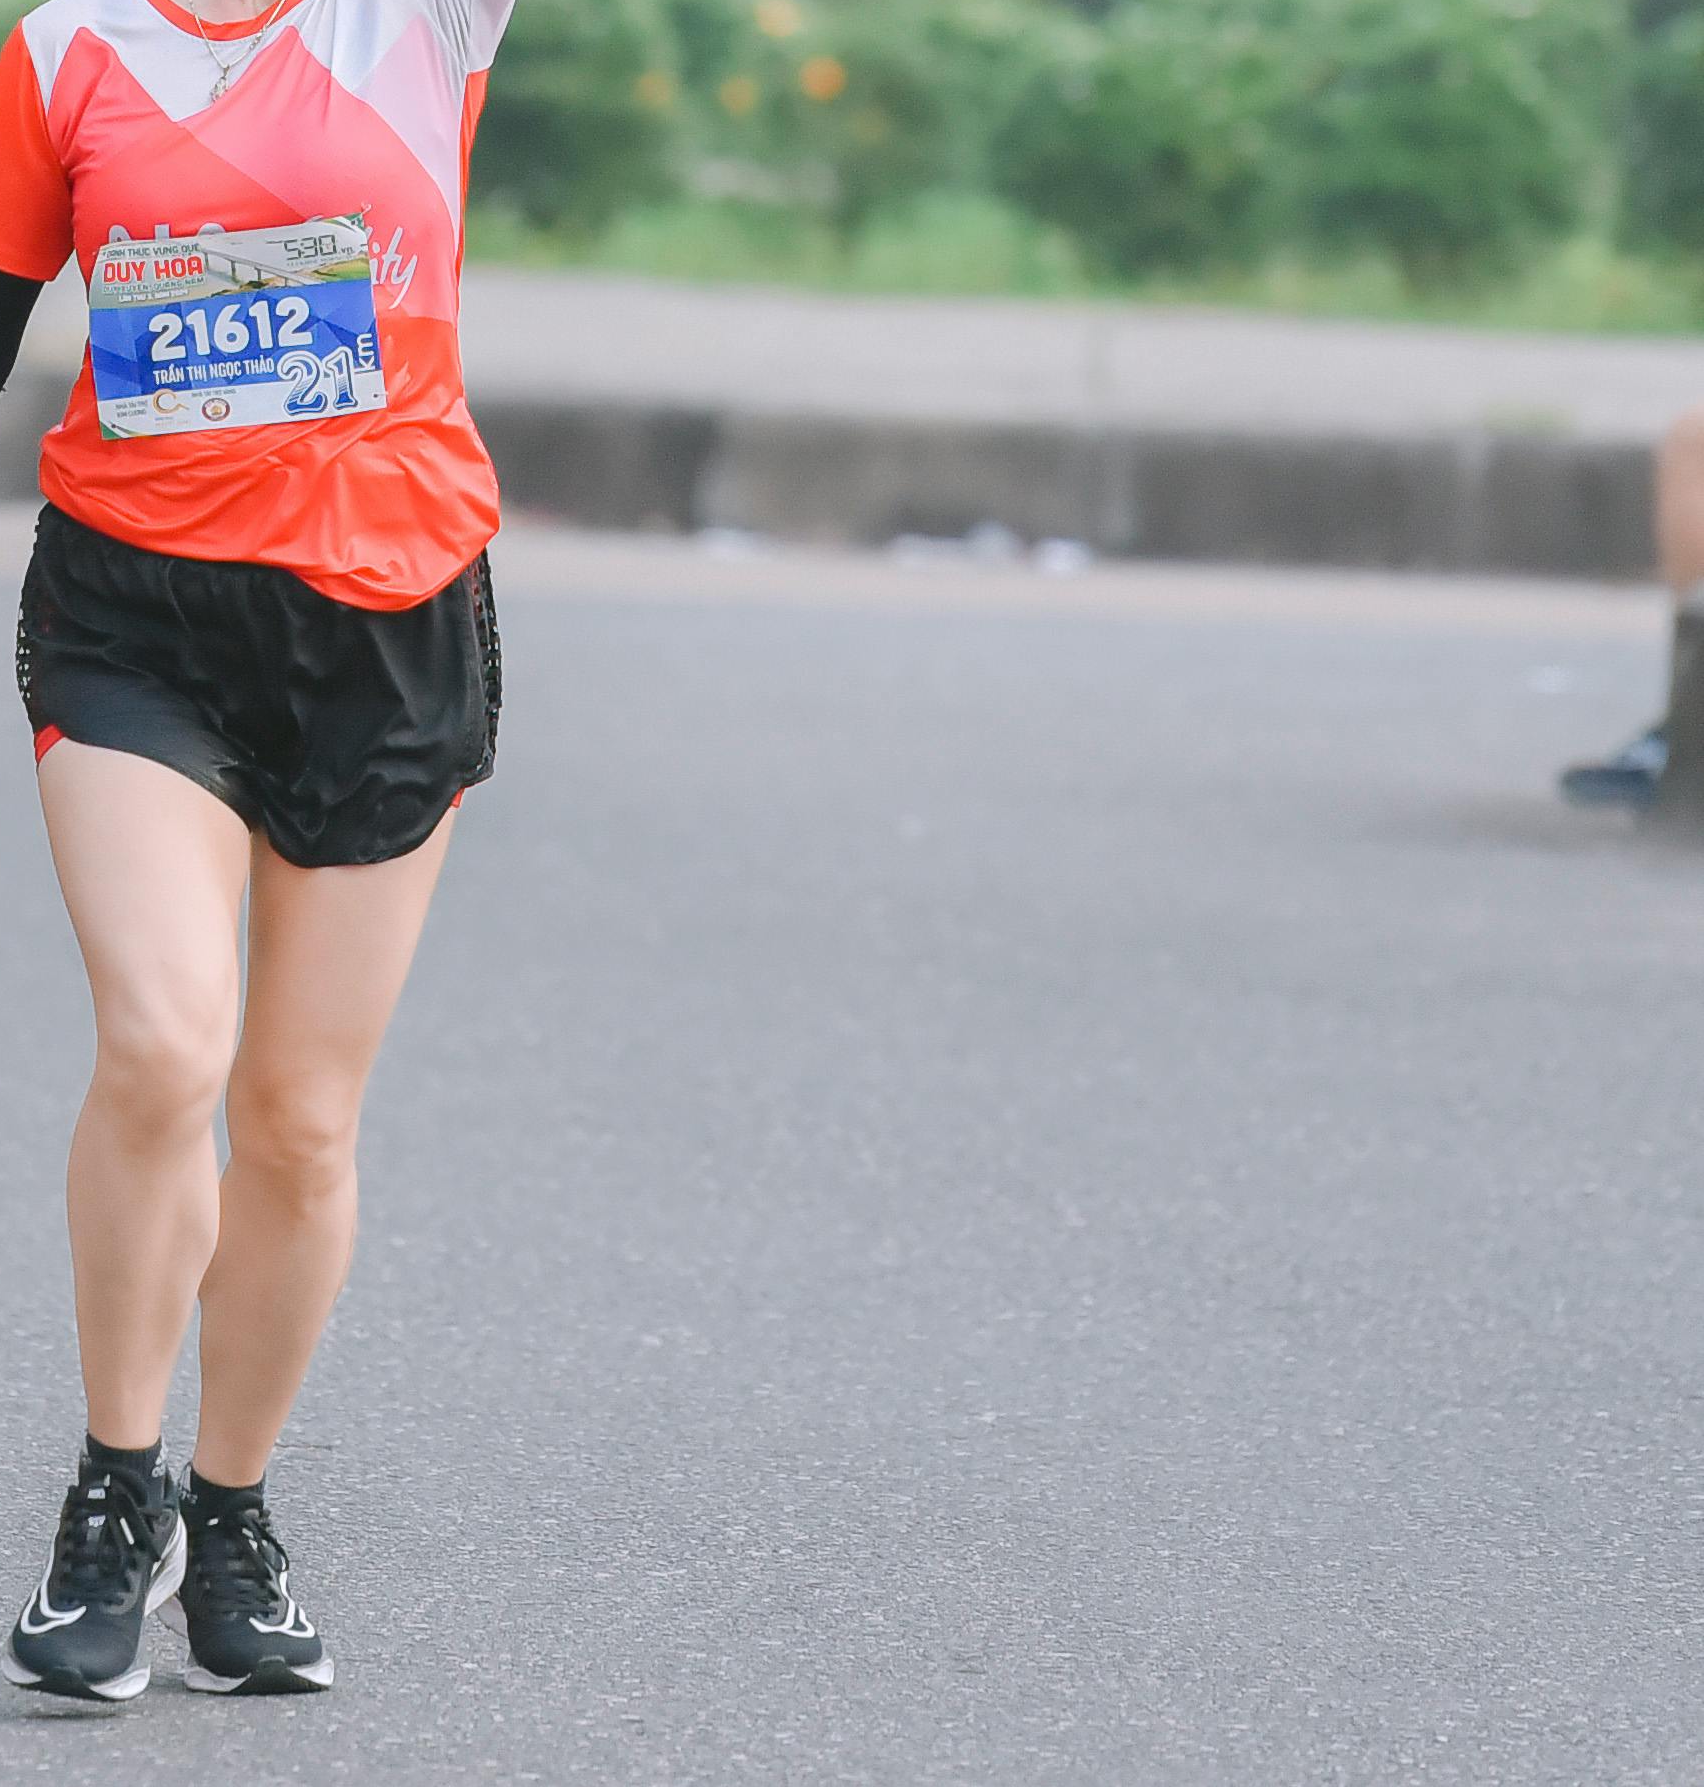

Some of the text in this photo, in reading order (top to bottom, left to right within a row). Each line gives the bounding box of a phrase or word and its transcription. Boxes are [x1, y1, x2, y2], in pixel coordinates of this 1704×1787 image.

[103, 260, 146, 283] DUY
[148, 296, 314, 362] 21612
[209, 361, 242, 380] NGỌC
[277, 345, 358, 416] 21
